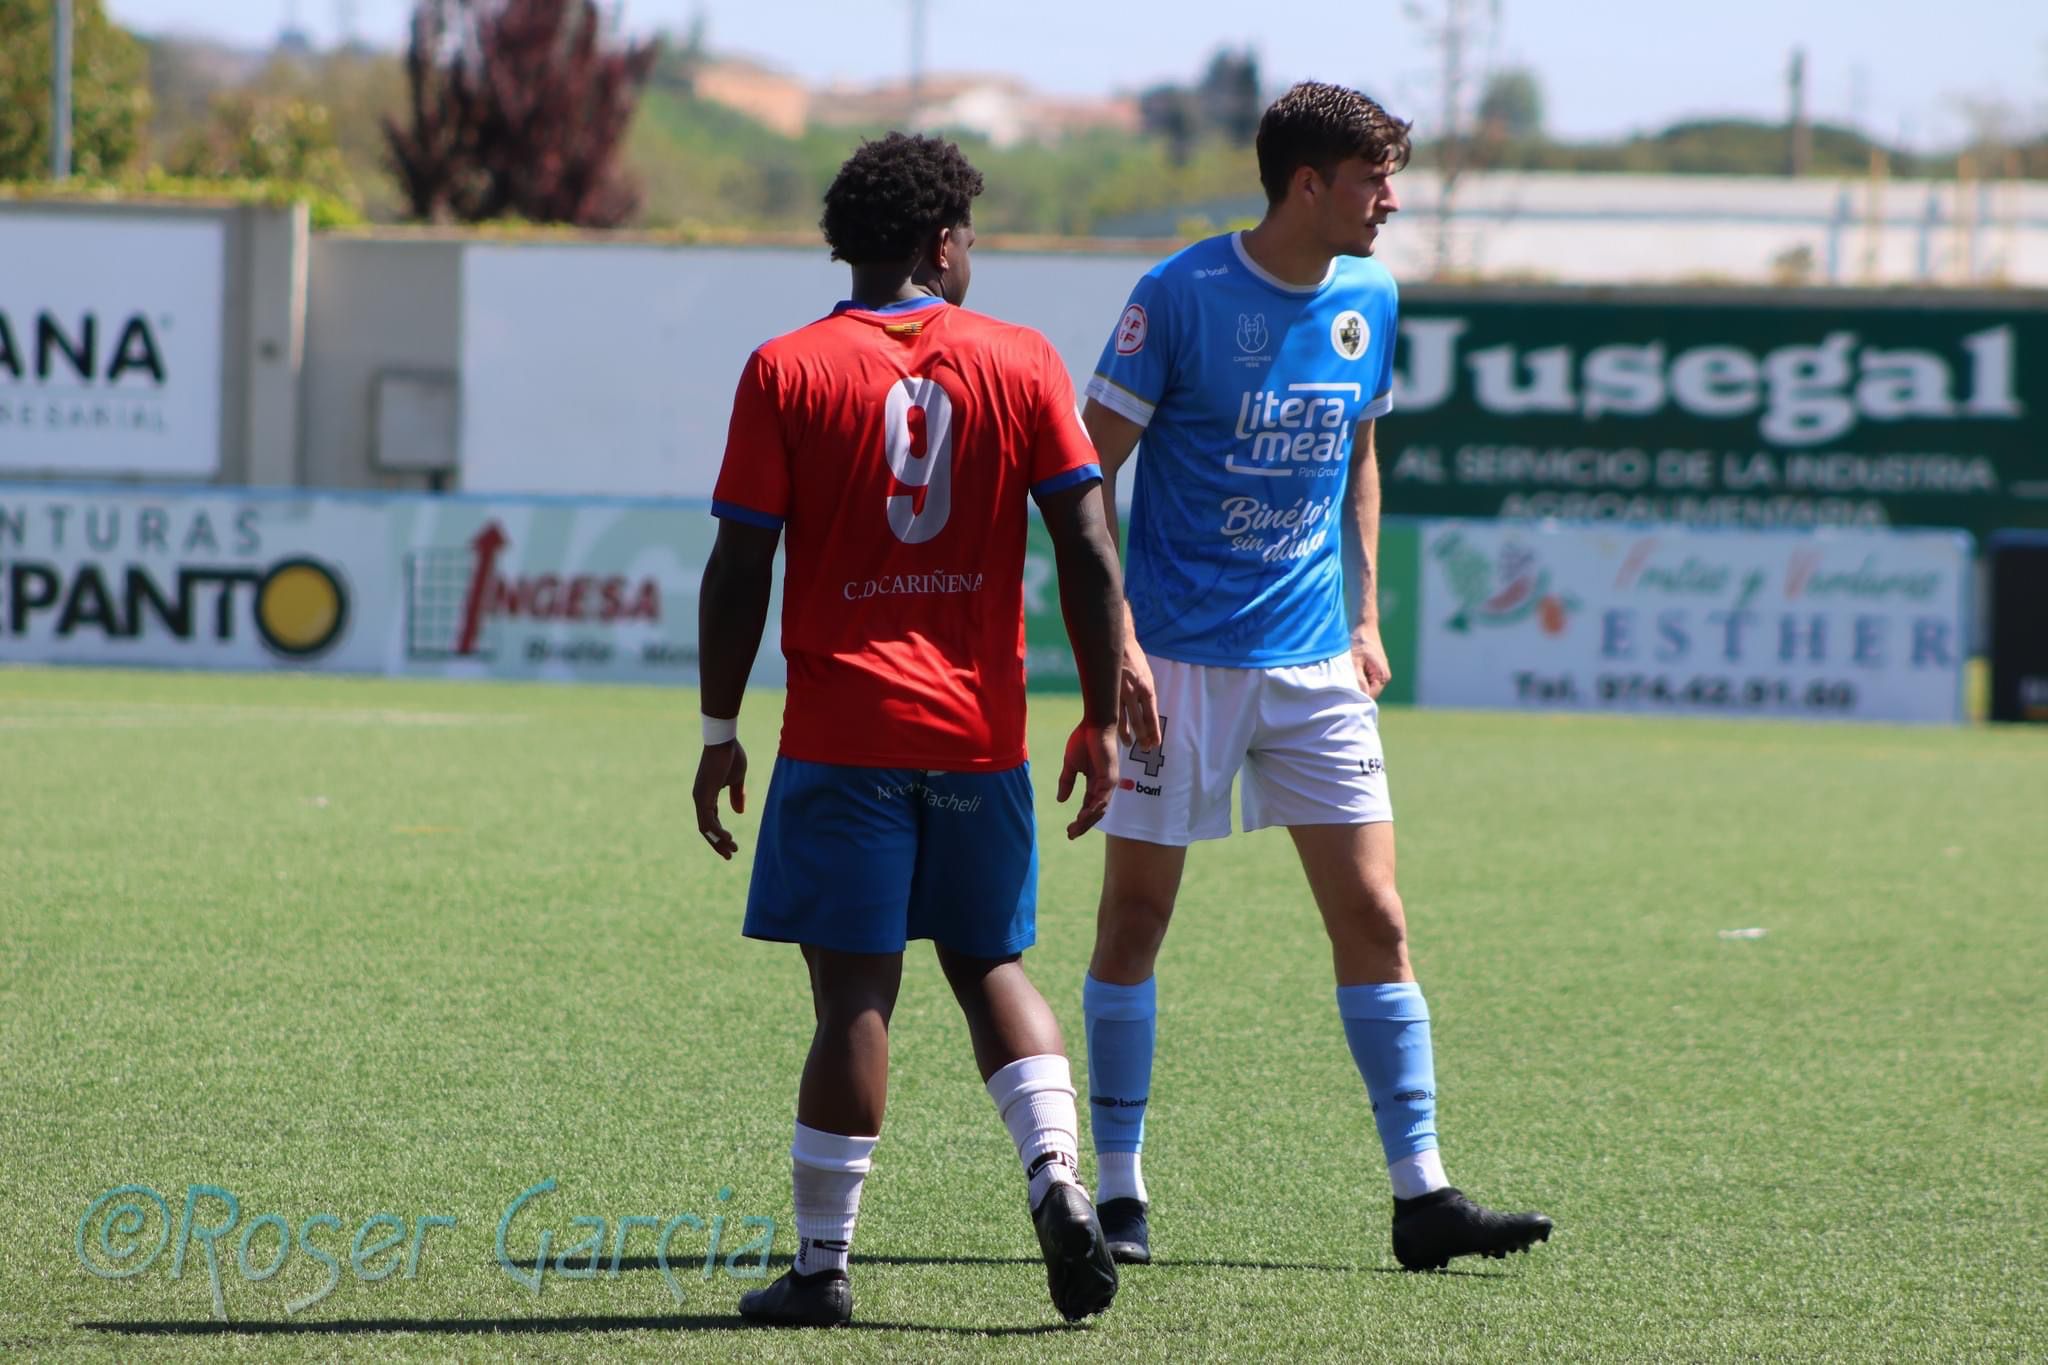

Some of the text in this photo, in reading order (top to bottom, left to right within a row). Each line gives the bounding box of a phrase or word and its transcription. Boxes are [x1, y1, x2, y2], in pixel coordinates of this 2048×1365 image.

[1391, 318, 2020, 444] Jusegal
[1235, 390, 1344, 439] litera
[1251, 420, 1349, 463] meat
[884, 377, 952, 544] 9
[1394, 447, 1444, 482] AL
[1456, 446, 1648, 488] SERVICIO
[1655, 450, 1713, 488] DE
[1722, 452, 1774, 490] LA
[1231, 535, 1263, 552] sin
[0, 561, 349, 660] PANTO
[1601, 608, 1956, 669] ESTHER
[1129, 715, 1168, 777] 4
